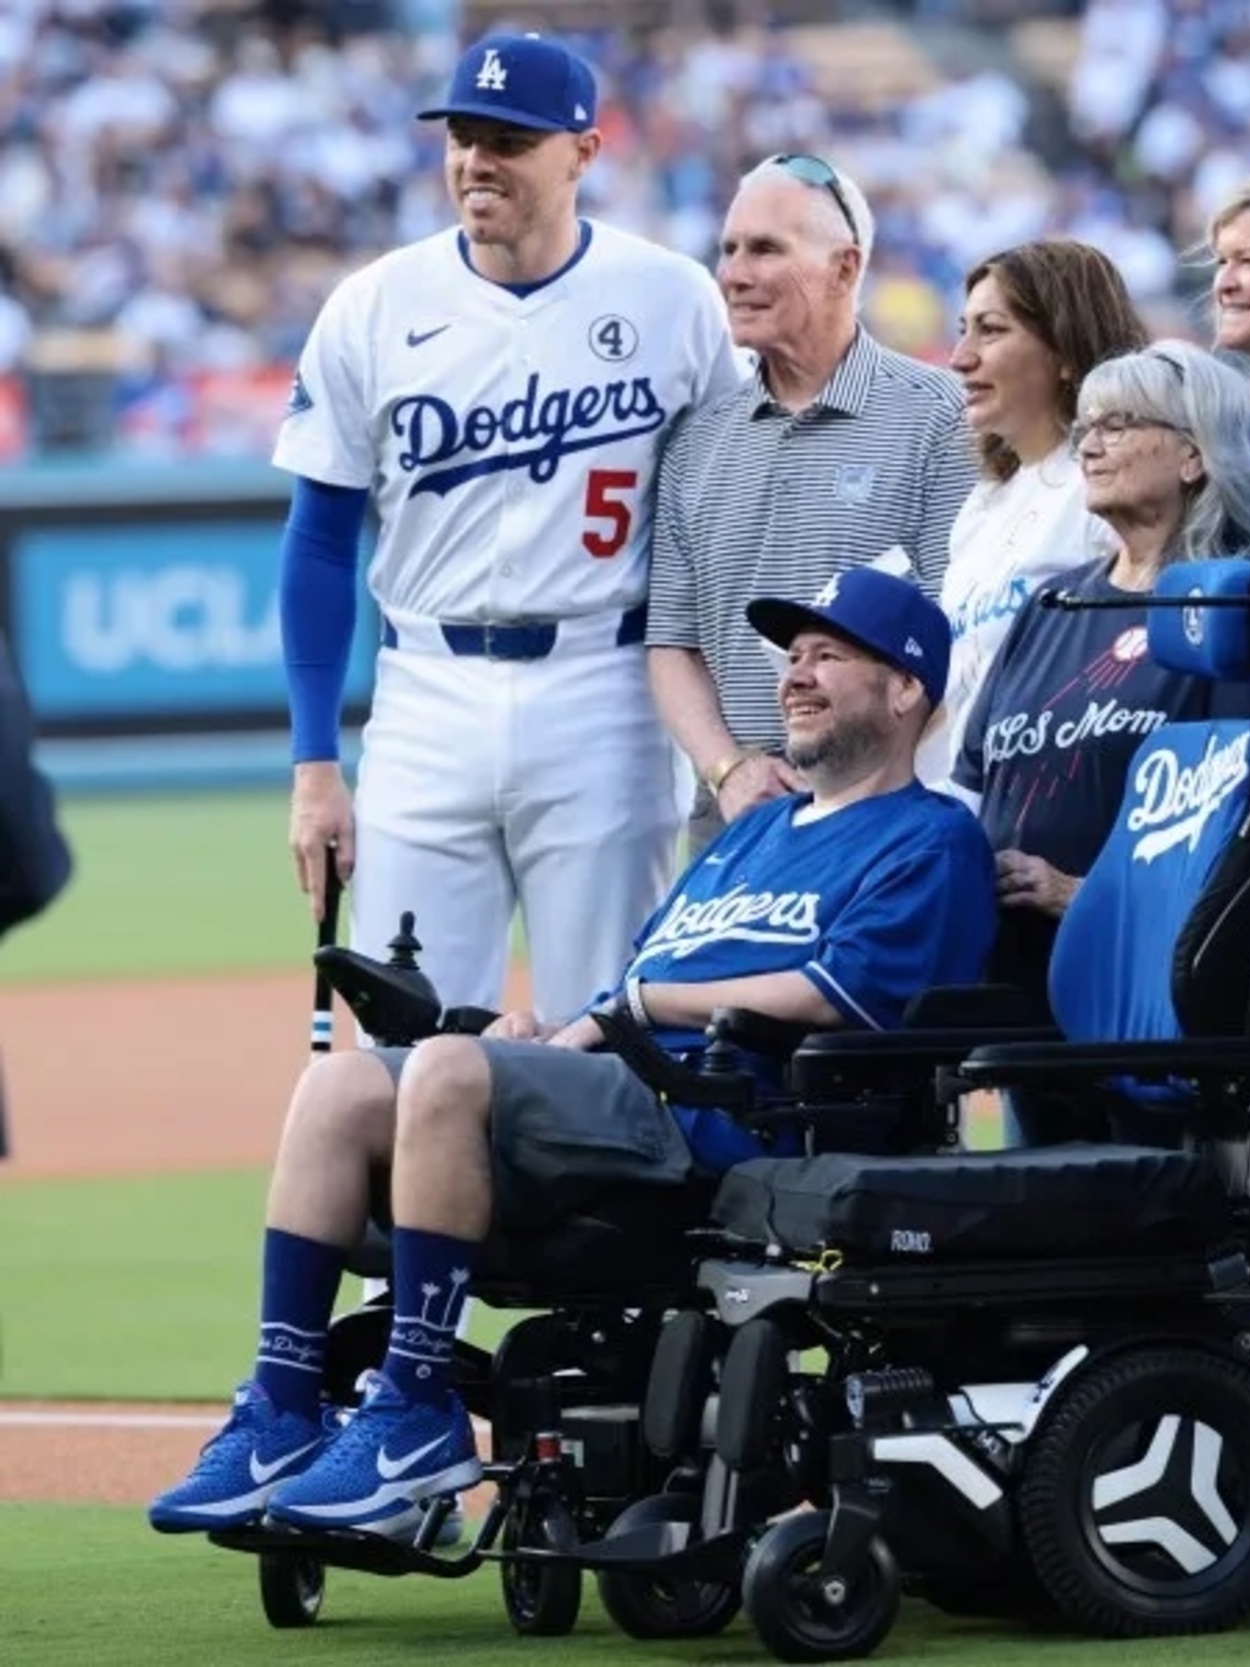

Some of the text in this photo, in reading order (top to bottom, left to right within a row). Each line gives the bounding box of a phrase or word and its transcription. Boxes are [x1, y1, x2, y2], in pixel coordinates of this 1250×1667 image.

[476, 49, 508, 90] LA
[597, 319, 624, 356] 4
[390, 371, 666, 485] Dodgers
[581, 468, 638, 559] 5
[63, 564, 281, 670] UCL
[1055, 698, 1168, 749] Mom
